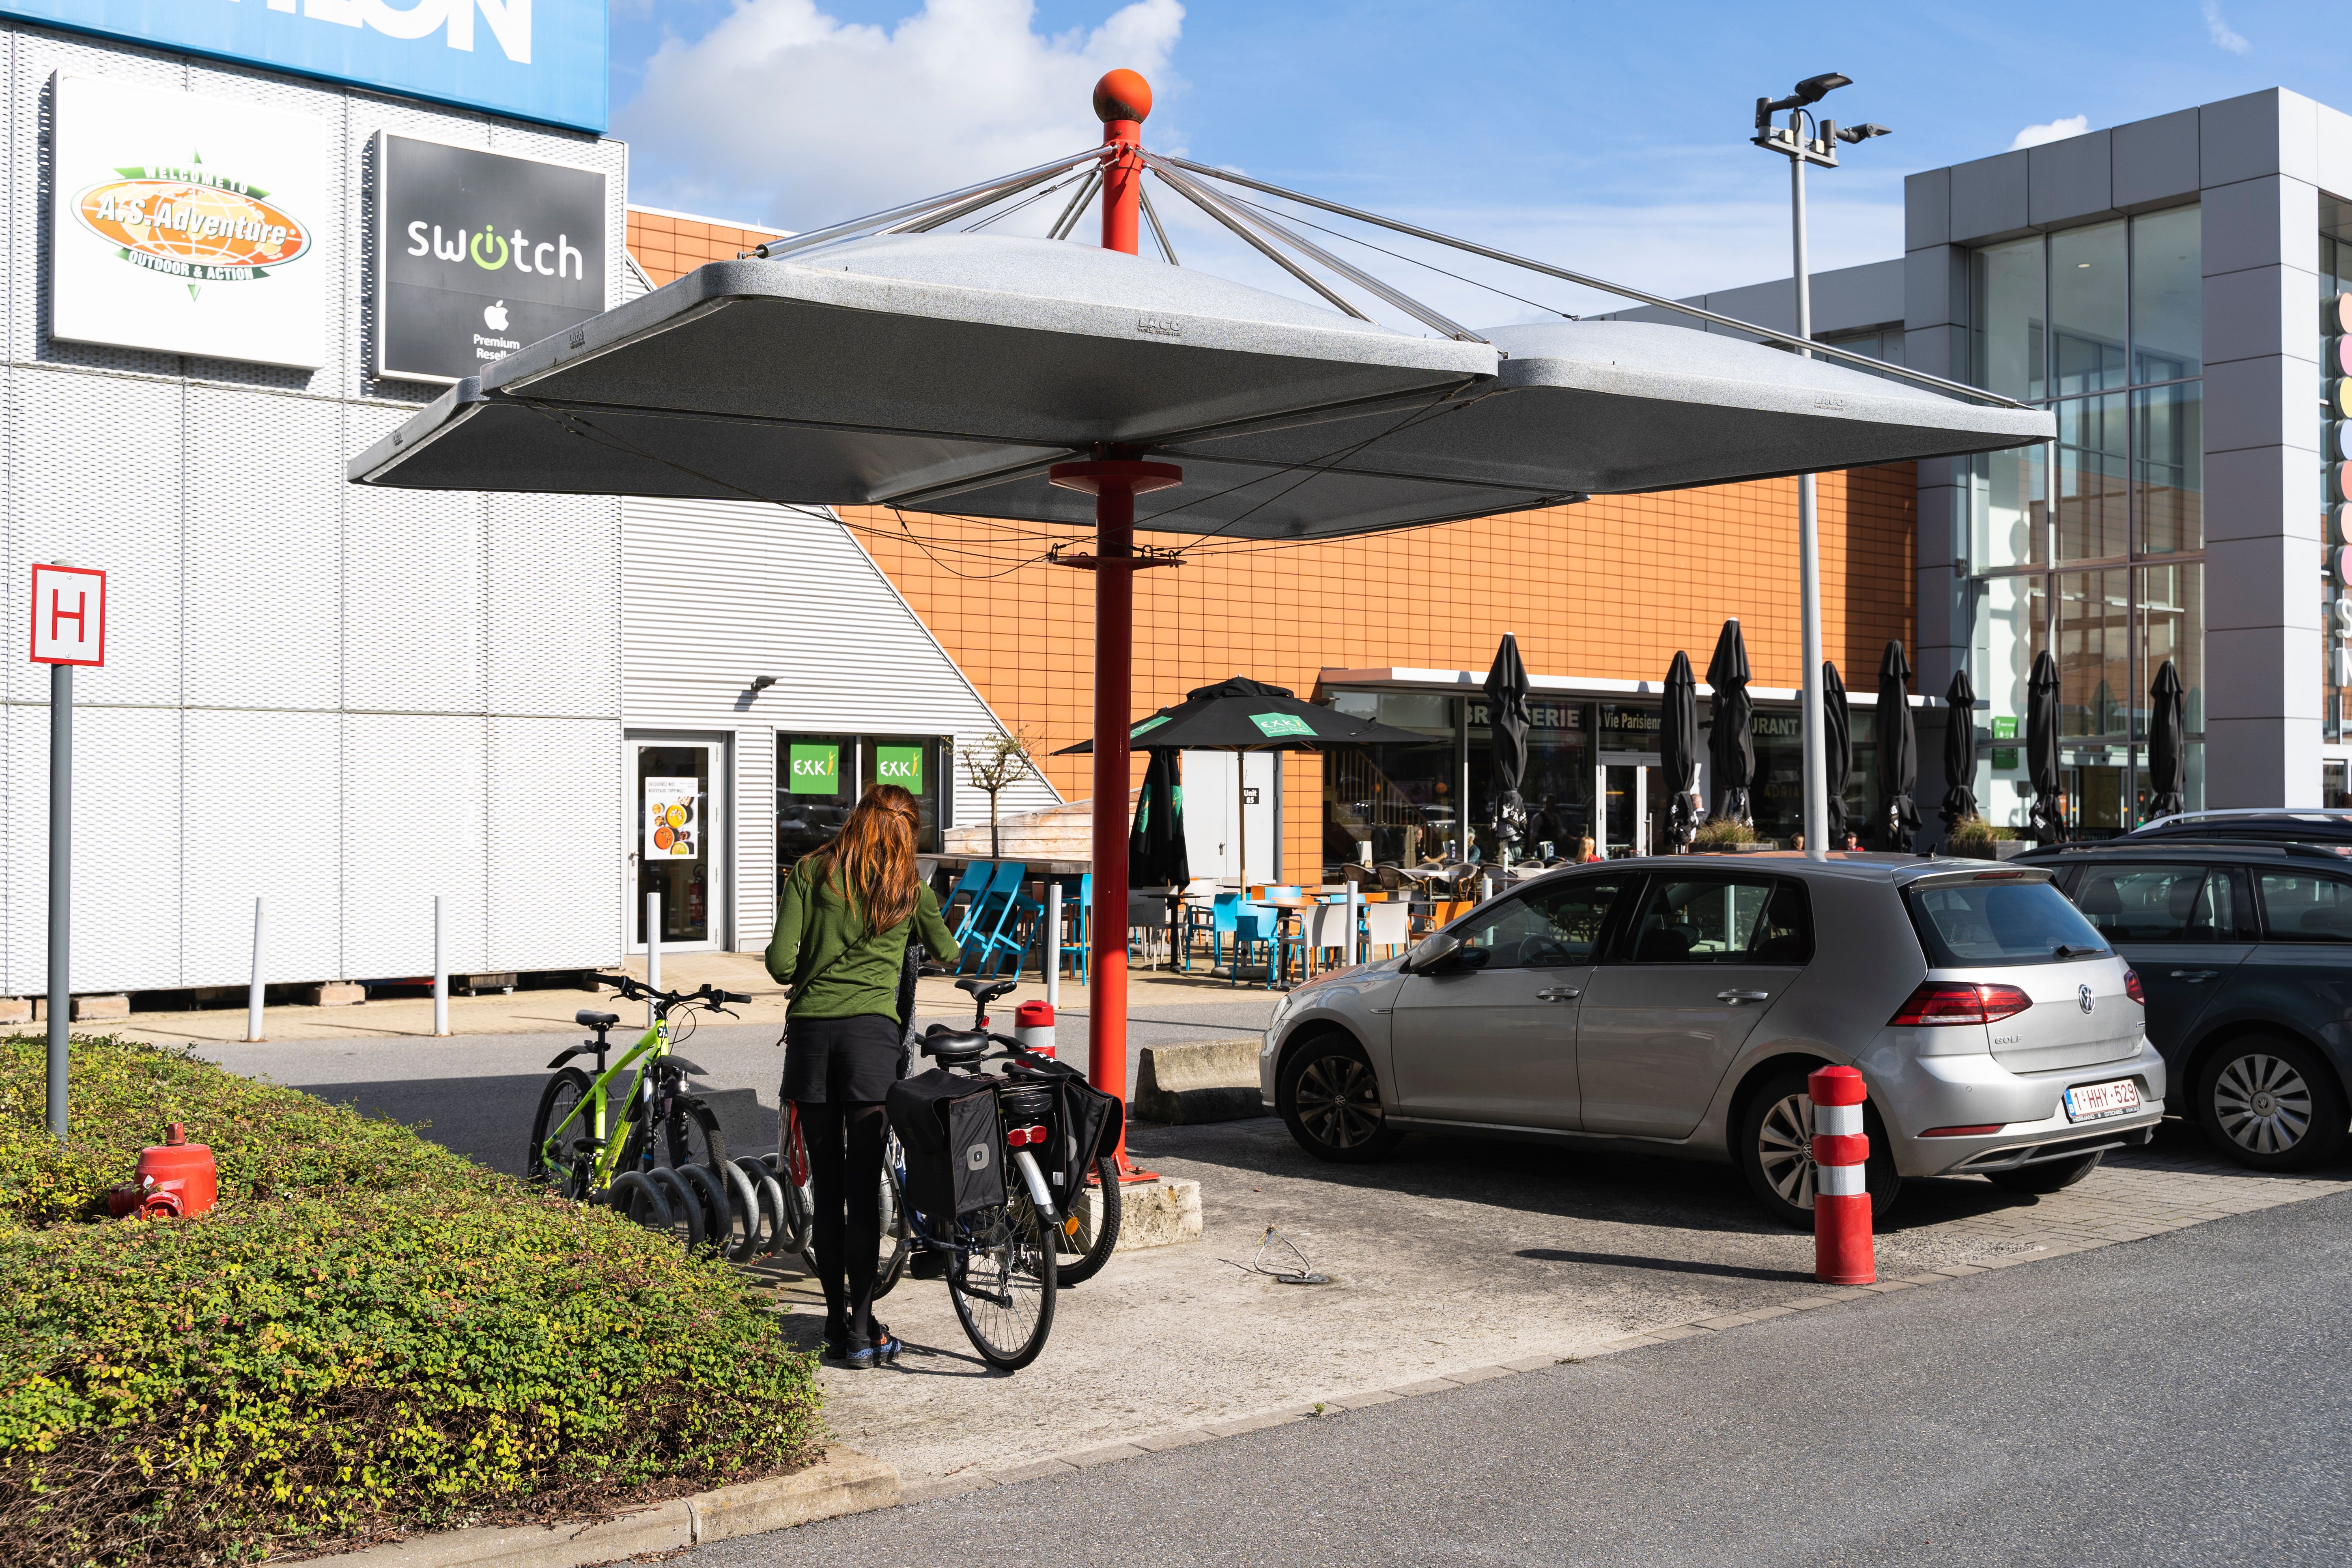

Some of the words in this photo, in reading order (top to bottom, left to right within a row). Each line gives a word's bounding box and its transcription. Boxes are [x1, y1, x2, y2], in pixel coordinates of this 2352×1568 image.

[143, 166, 224, 188] WELCOME
[228, 181, 248, 194] TO
[128, 251, 189, 277] OUTDOOR
[194, 266, 203, 279] &
[207, 267, 254, 281] ACTION
[473, 333, 520, 349] Premium
[476, 348, 511, 360] Resell
[52, 589, 85, 643] H
[1604, 712, 1619, 727] Vie
[1621, 712, 1661, 730] Parisien
[1995, 1035, 2023, 1045] GOLF
[2068, 1104, 2074, 1113] B
[2073, 1114, 2095, 1123] HERMAND
